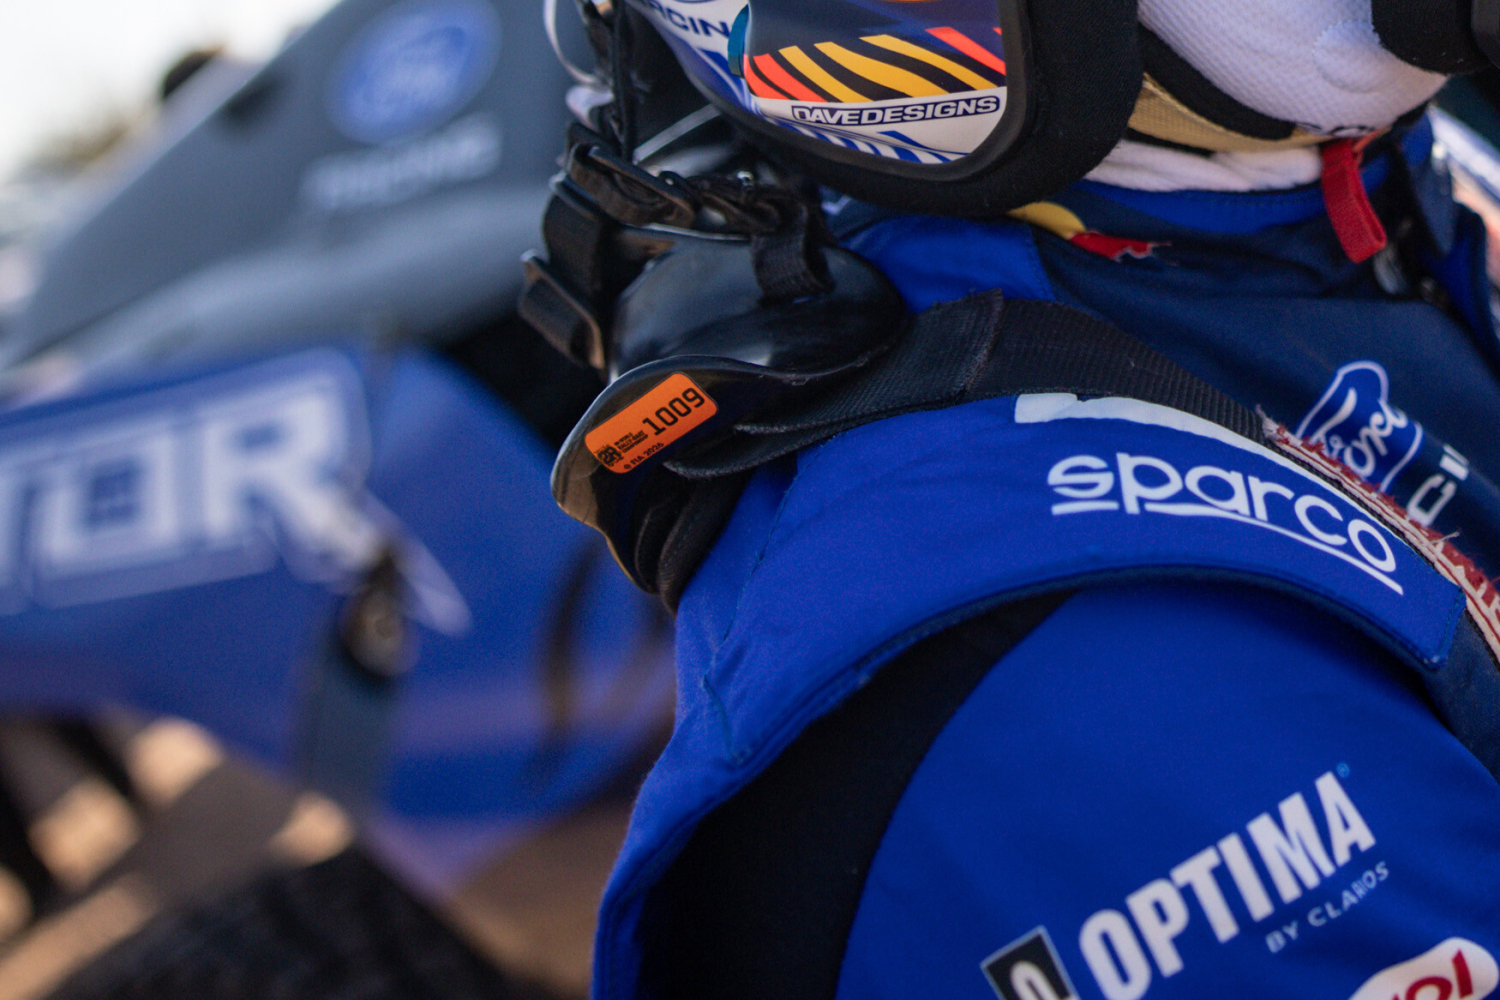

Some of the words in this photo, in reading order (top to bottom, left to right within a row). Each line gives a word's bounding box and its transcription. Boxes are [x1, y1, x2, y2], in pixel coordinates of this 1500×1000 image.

[794, 96, 998, 125] DAVEDESIGNS
[642, 387, 705, 436] 1009
[1047, 452, 1397, 573] sparco
[1079, 771, 1376, 1000] OPTIMA
[1266, 920, 1299, 953] BY
[1307, 861, 1389, 927] CLARIOS
